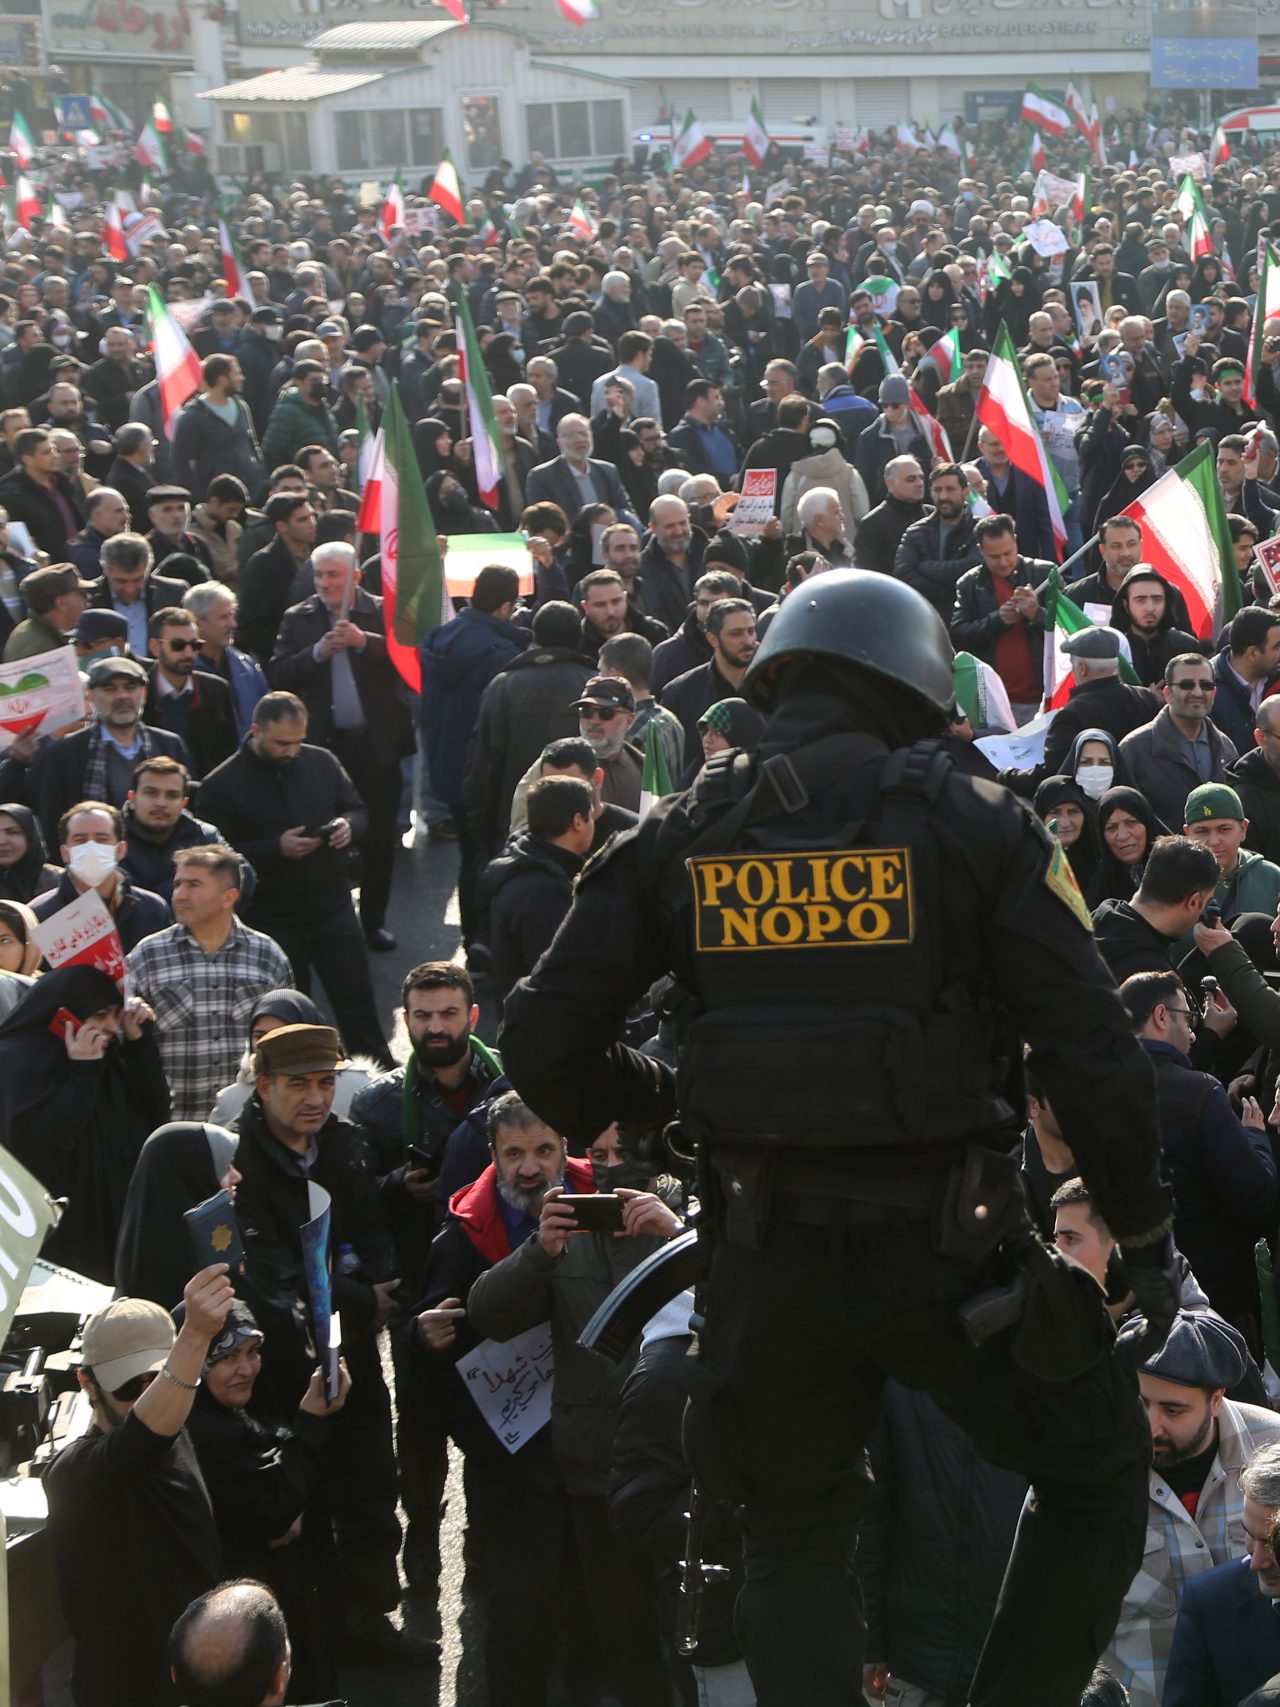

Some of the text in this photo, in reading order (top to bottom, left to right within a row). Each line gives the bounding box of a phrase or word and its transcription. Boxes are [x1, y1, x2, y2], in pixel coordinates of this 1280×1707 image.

[939, 24, 984, 37] BANK
[986, 22, 1057, 36] SADERAT
[1058, 21, 1097, 35] IRAN
[698, 855, 904, 906] POLICE
[720, 902, 891, 946] NOPO
